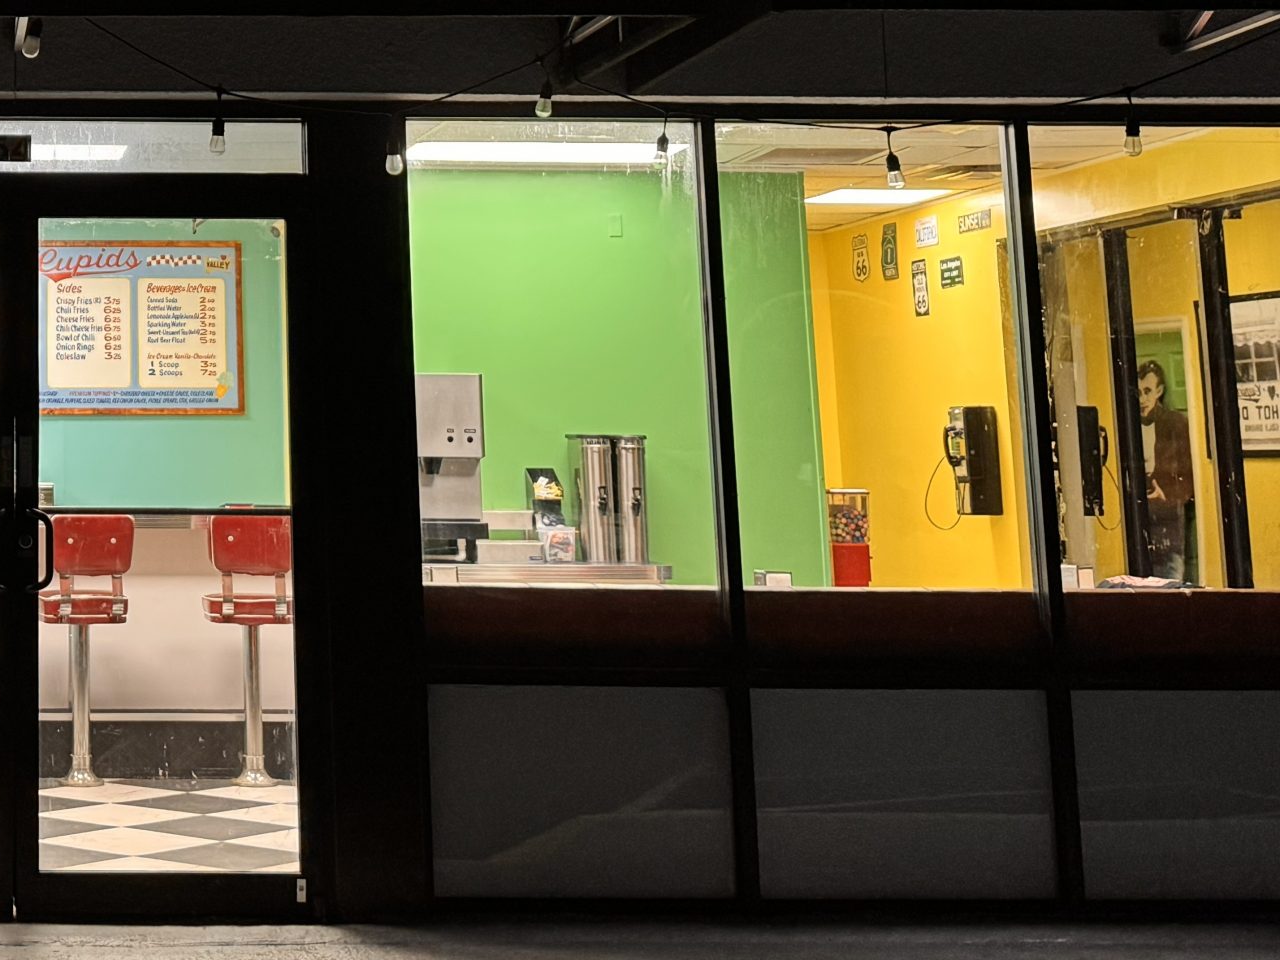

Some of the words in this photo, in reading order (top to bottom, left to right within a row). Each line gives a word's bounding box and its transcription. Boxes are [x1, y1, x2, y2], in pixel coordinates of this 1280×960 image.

[959, 212, 982, 233] SUNSET
[856, 259, 868, 277] 66
[56, 283, 83, 294] Sides
[76, 296, 93, 305] Fries
[917, 294, 927, 310] 66
[73, 306, 90, 314] Fries
[56, 315, 79, 323] Cheese
[79, 314, 95, 323] Fries
[56, 333, 73, 342] Bowl
[56, 342, 76, 351] Onion
[76, 342, 95, 352] Rings
[56, 351, 87, 360] Coleslaw
[158, 360, 180, 369] Scoop
[148, 368, 157, 376] 2
[158, 369, 184, 377] Scoops
